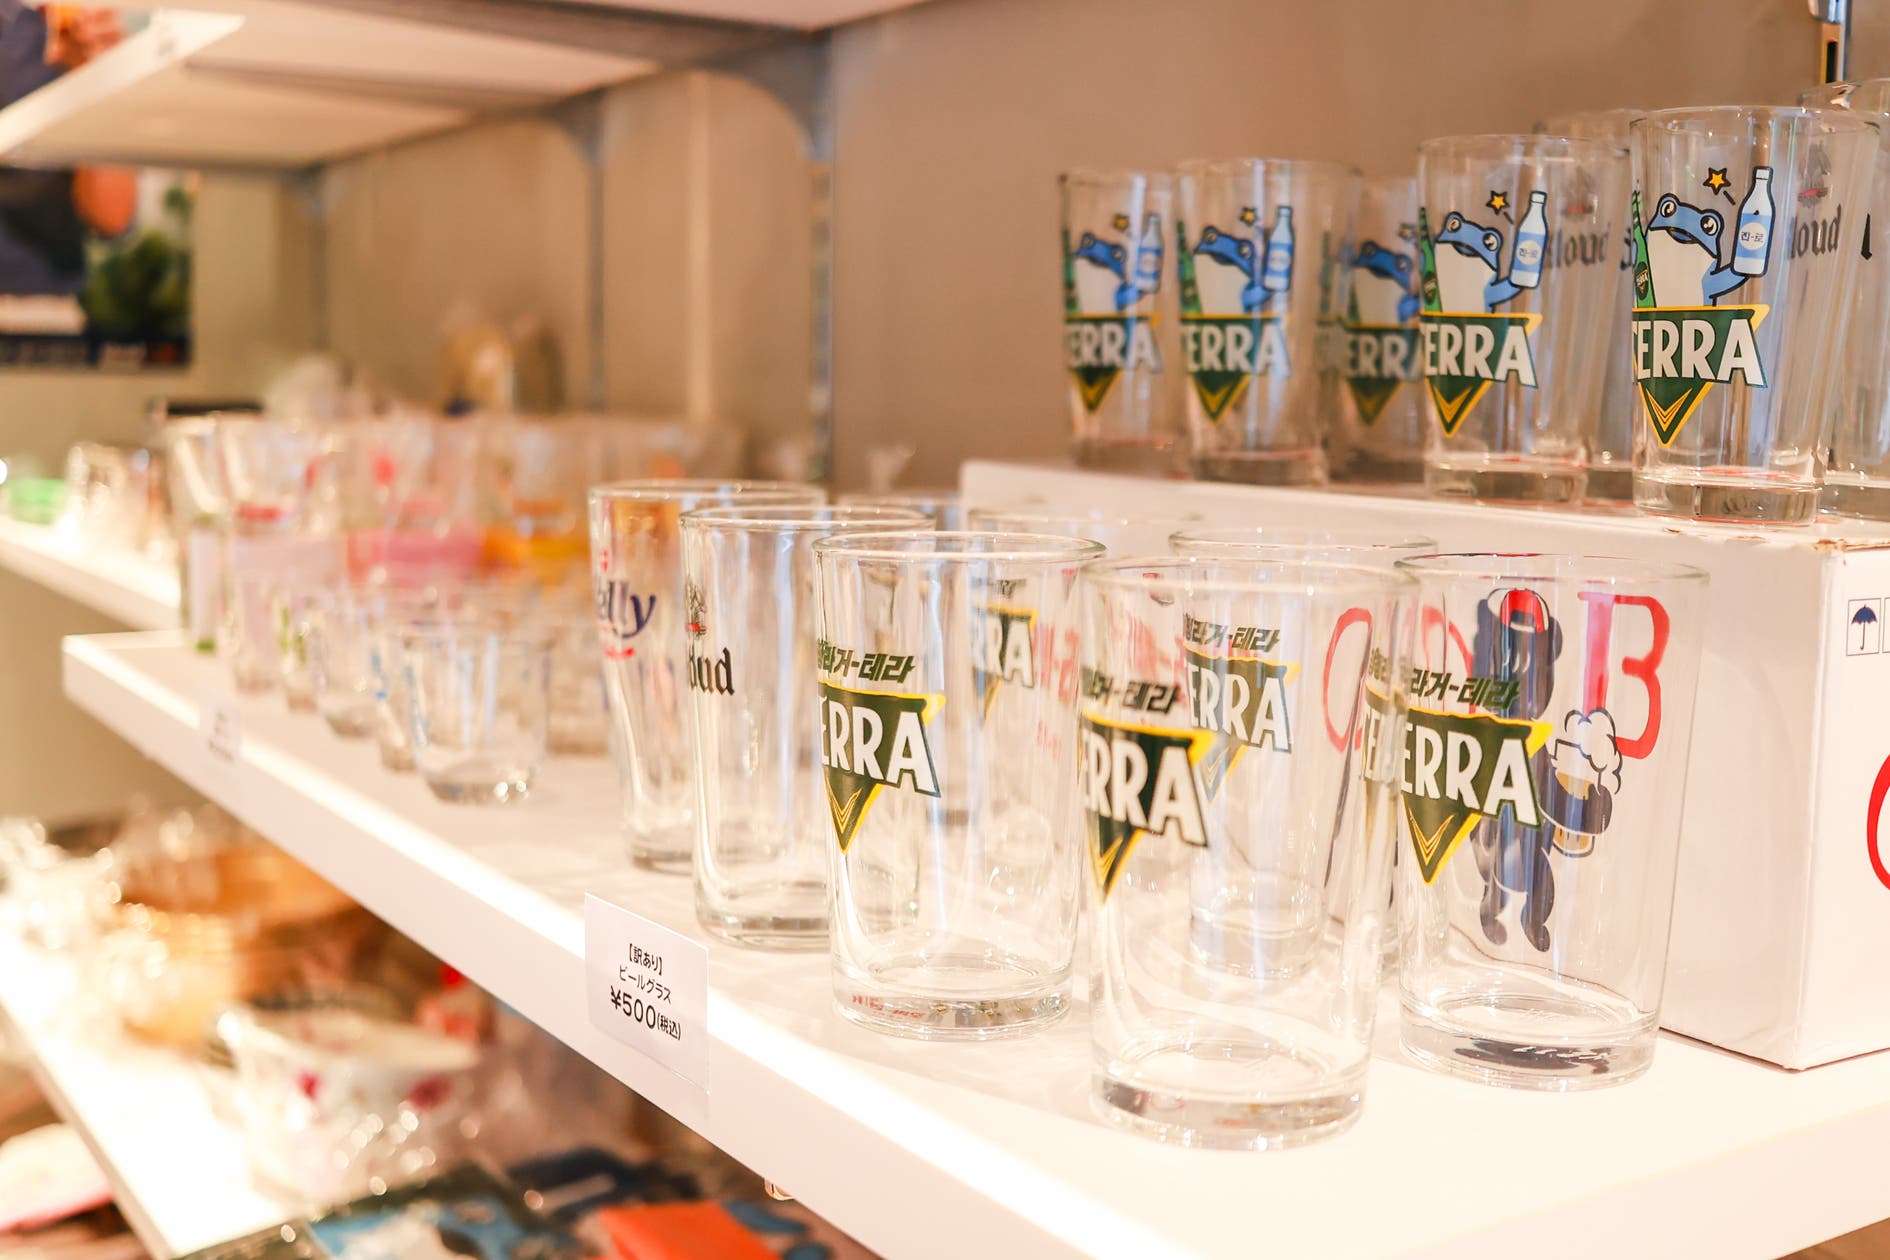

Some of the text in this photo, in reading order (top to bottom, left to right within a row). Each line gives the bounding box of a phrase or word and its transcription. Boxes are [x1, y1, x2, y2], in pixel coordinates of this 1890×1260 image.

[1787, 204, 1842, 260] loud
[1067, 322, 1162, 373] ERRA
[1184, 323, 1293, 378] ERRA
[1421, 322, 1539, 388] ERRA
[598, 580, 656, 639] elly
[688, 646, 736, 696] oud
[1189, 664, 1292, 754] ERRA
[820, 696, 941, 798] ERRA
[1401, 719, 1542, 830] ERRA
[620, 964, 671, 1004] ビールグラス
